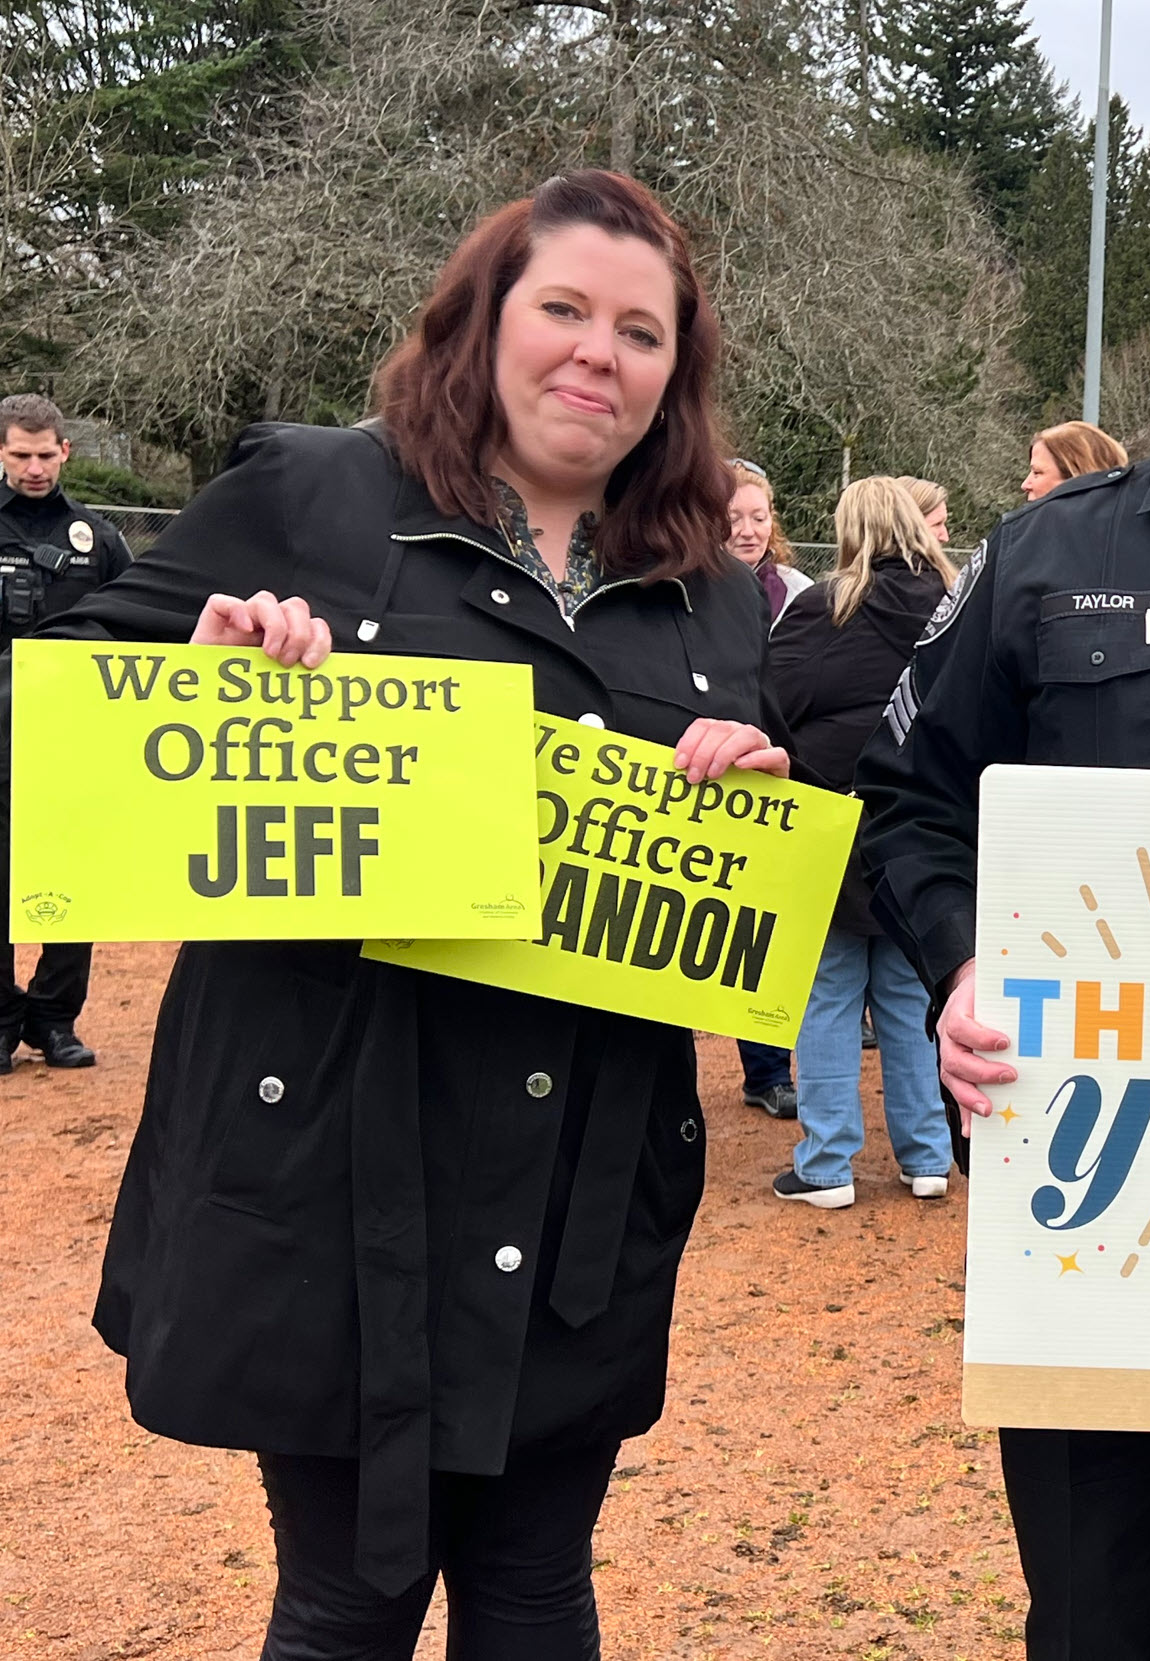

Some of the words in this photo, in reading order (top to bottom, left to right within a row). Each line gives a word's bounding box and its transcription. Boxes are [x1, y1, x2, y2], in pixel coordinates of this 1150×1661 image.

[1072, 593, 1135, 610] TAYLOR
[91, 653, 200, 702] We
[217, 657, 462, 722] Support
[143, 716, 419, 786] Officer
[590, 743, 800, 832] Support
[188, 805, 380, 898] JEFF
[532, 858, 778, 993] ANDON
